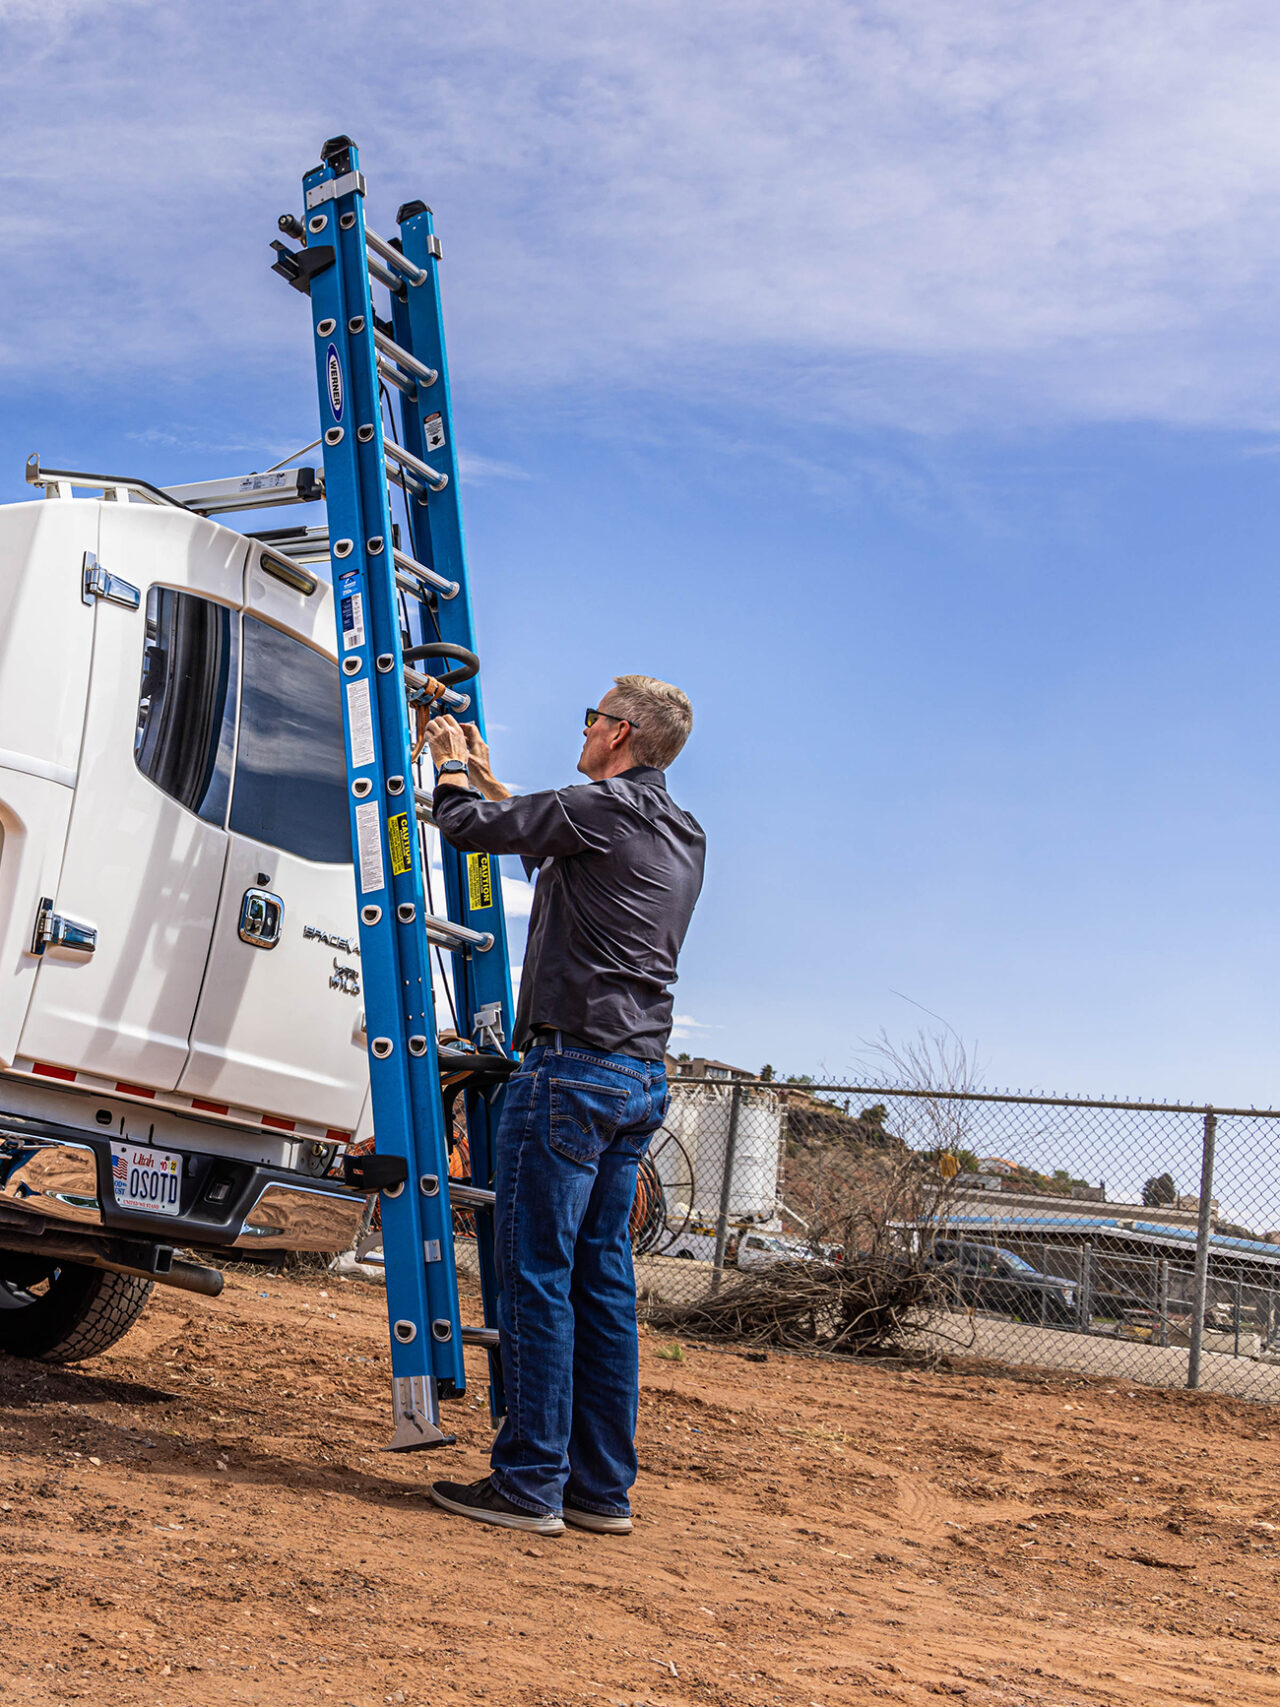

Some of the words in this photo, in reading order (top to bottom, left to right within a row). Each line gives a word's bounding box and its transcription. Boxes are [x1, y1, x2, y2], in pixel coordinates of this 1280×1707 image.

[330, 360, 340, 406] WERNER
[481, 857, 491, 902] CAUTION
[329, 976, 360, 997] WILD
[133, 1153, 154, 1168] Utah
